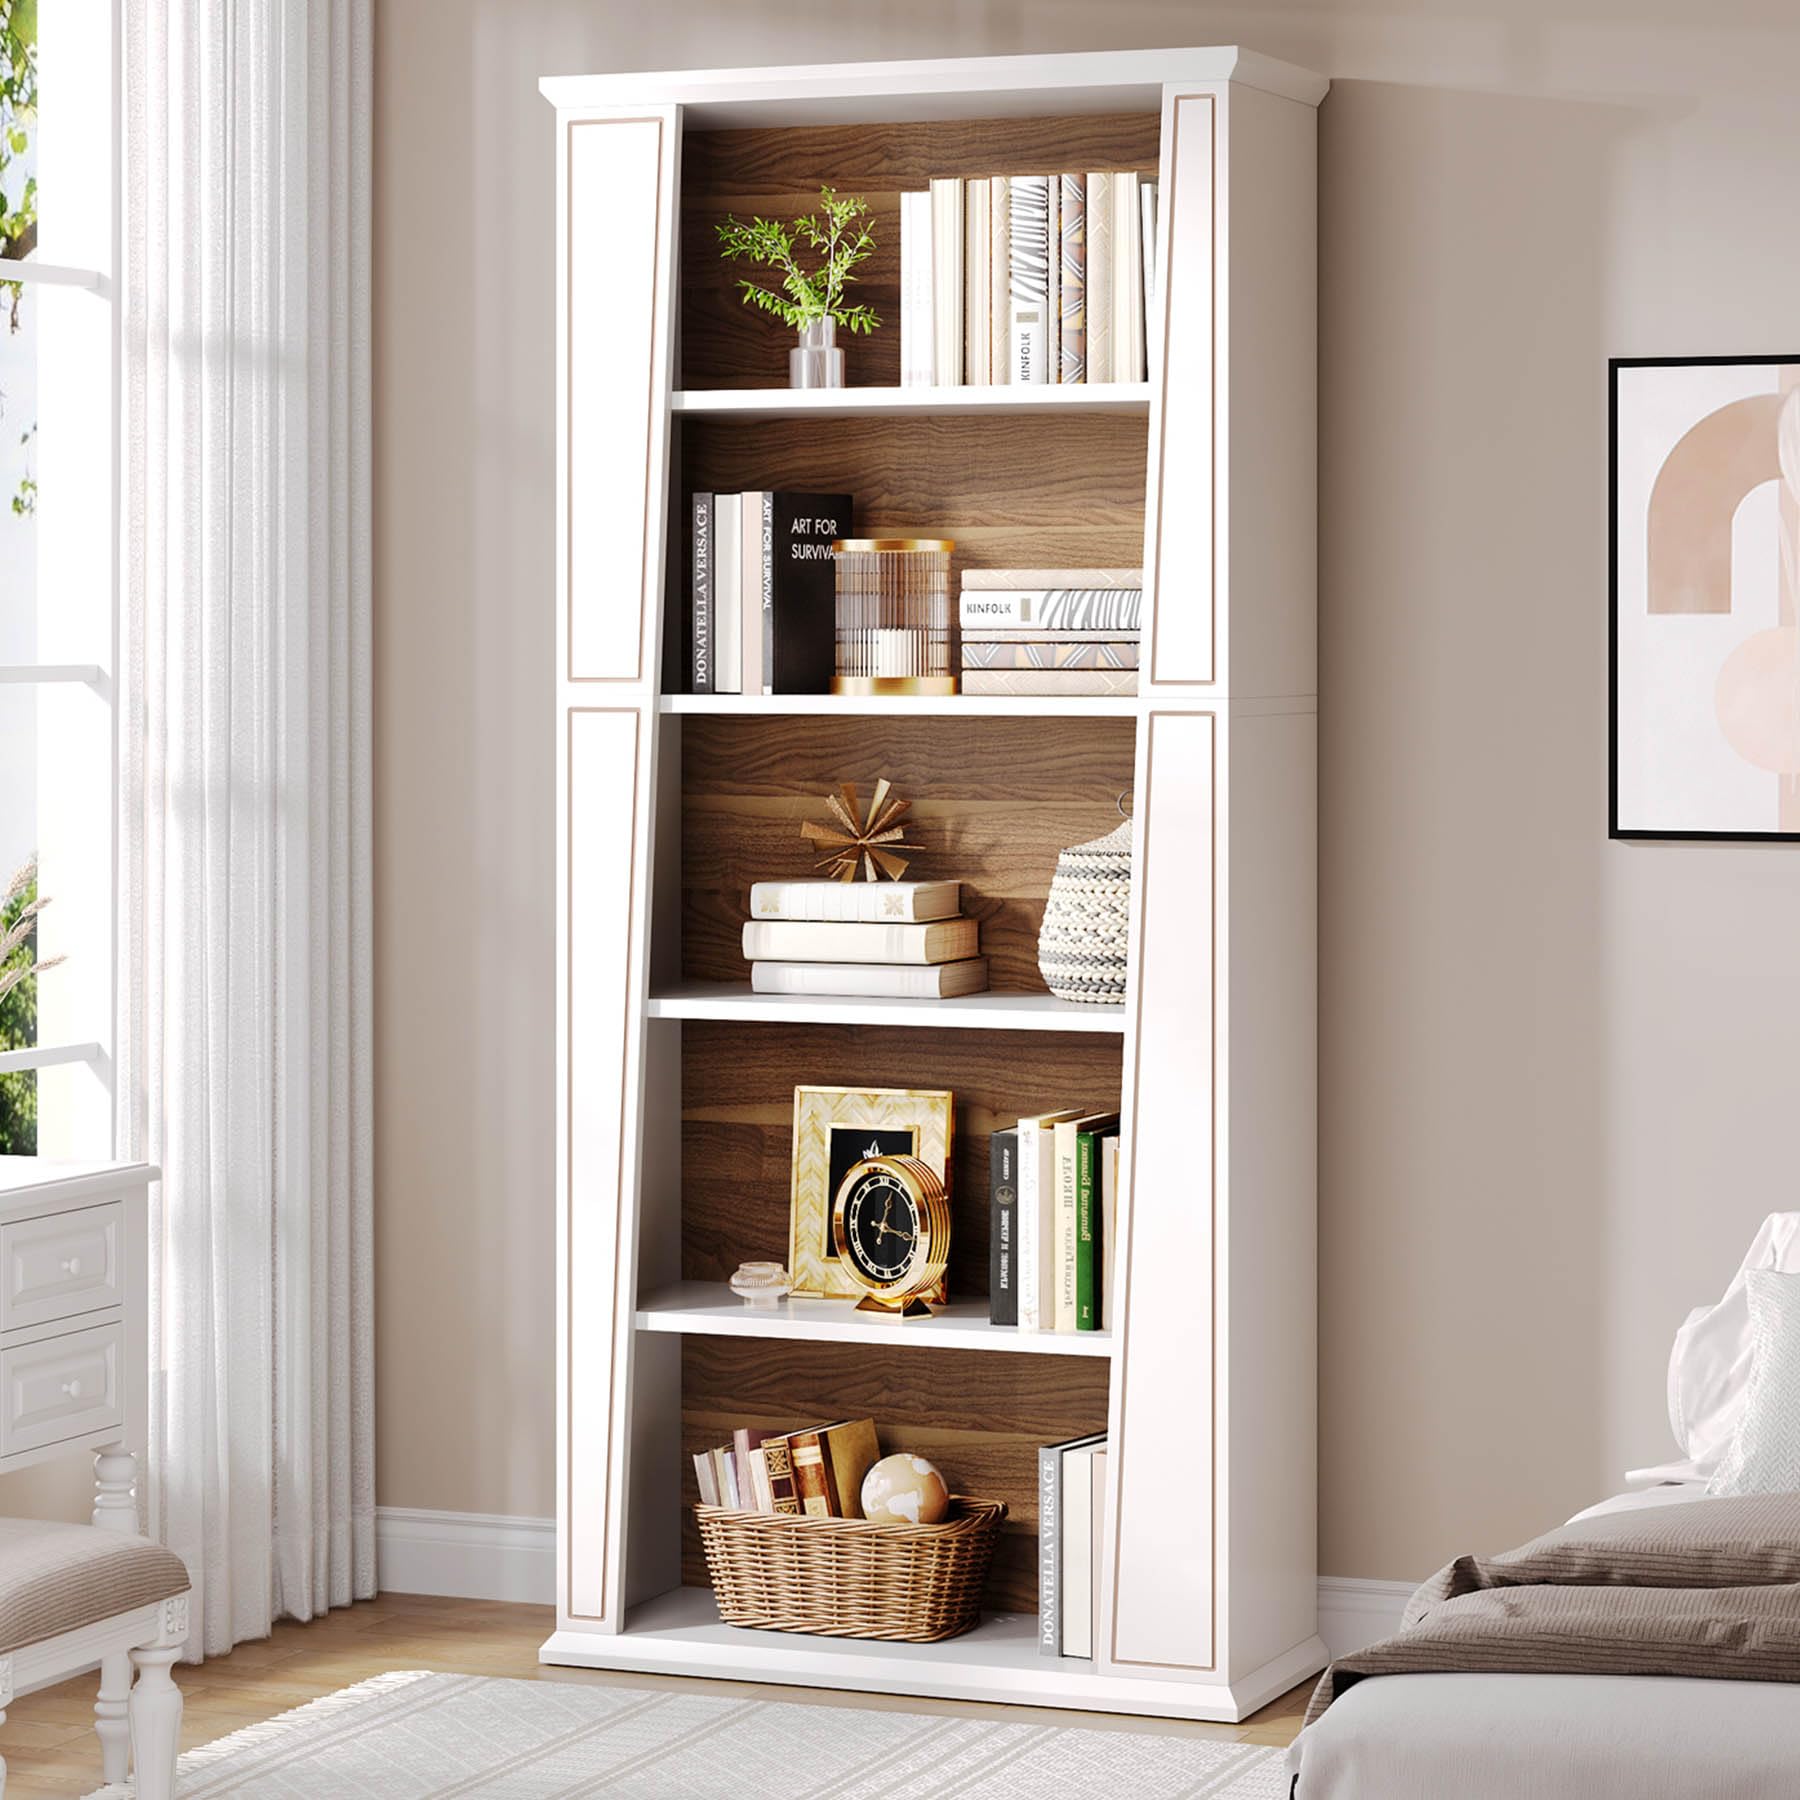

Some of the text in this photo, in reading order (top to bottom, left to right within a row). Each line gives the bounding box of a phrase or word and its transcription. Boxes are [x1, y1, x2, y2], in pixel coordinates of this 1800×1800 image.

[1021, 332, 1031, 381] KINFOLK
[791, 517, 837, 535] ART FOR
[763, 499, 772, 610] ART FOR SURVIVAL
[791, 543, 840, 560] SURVIVA
[696, 503, 708, 684] DONATELLA VERSACE
[966, 602, 1012, 615] KINFOLK
[1043, 1460, 1055, 1645] DONATELLA VERSACE
